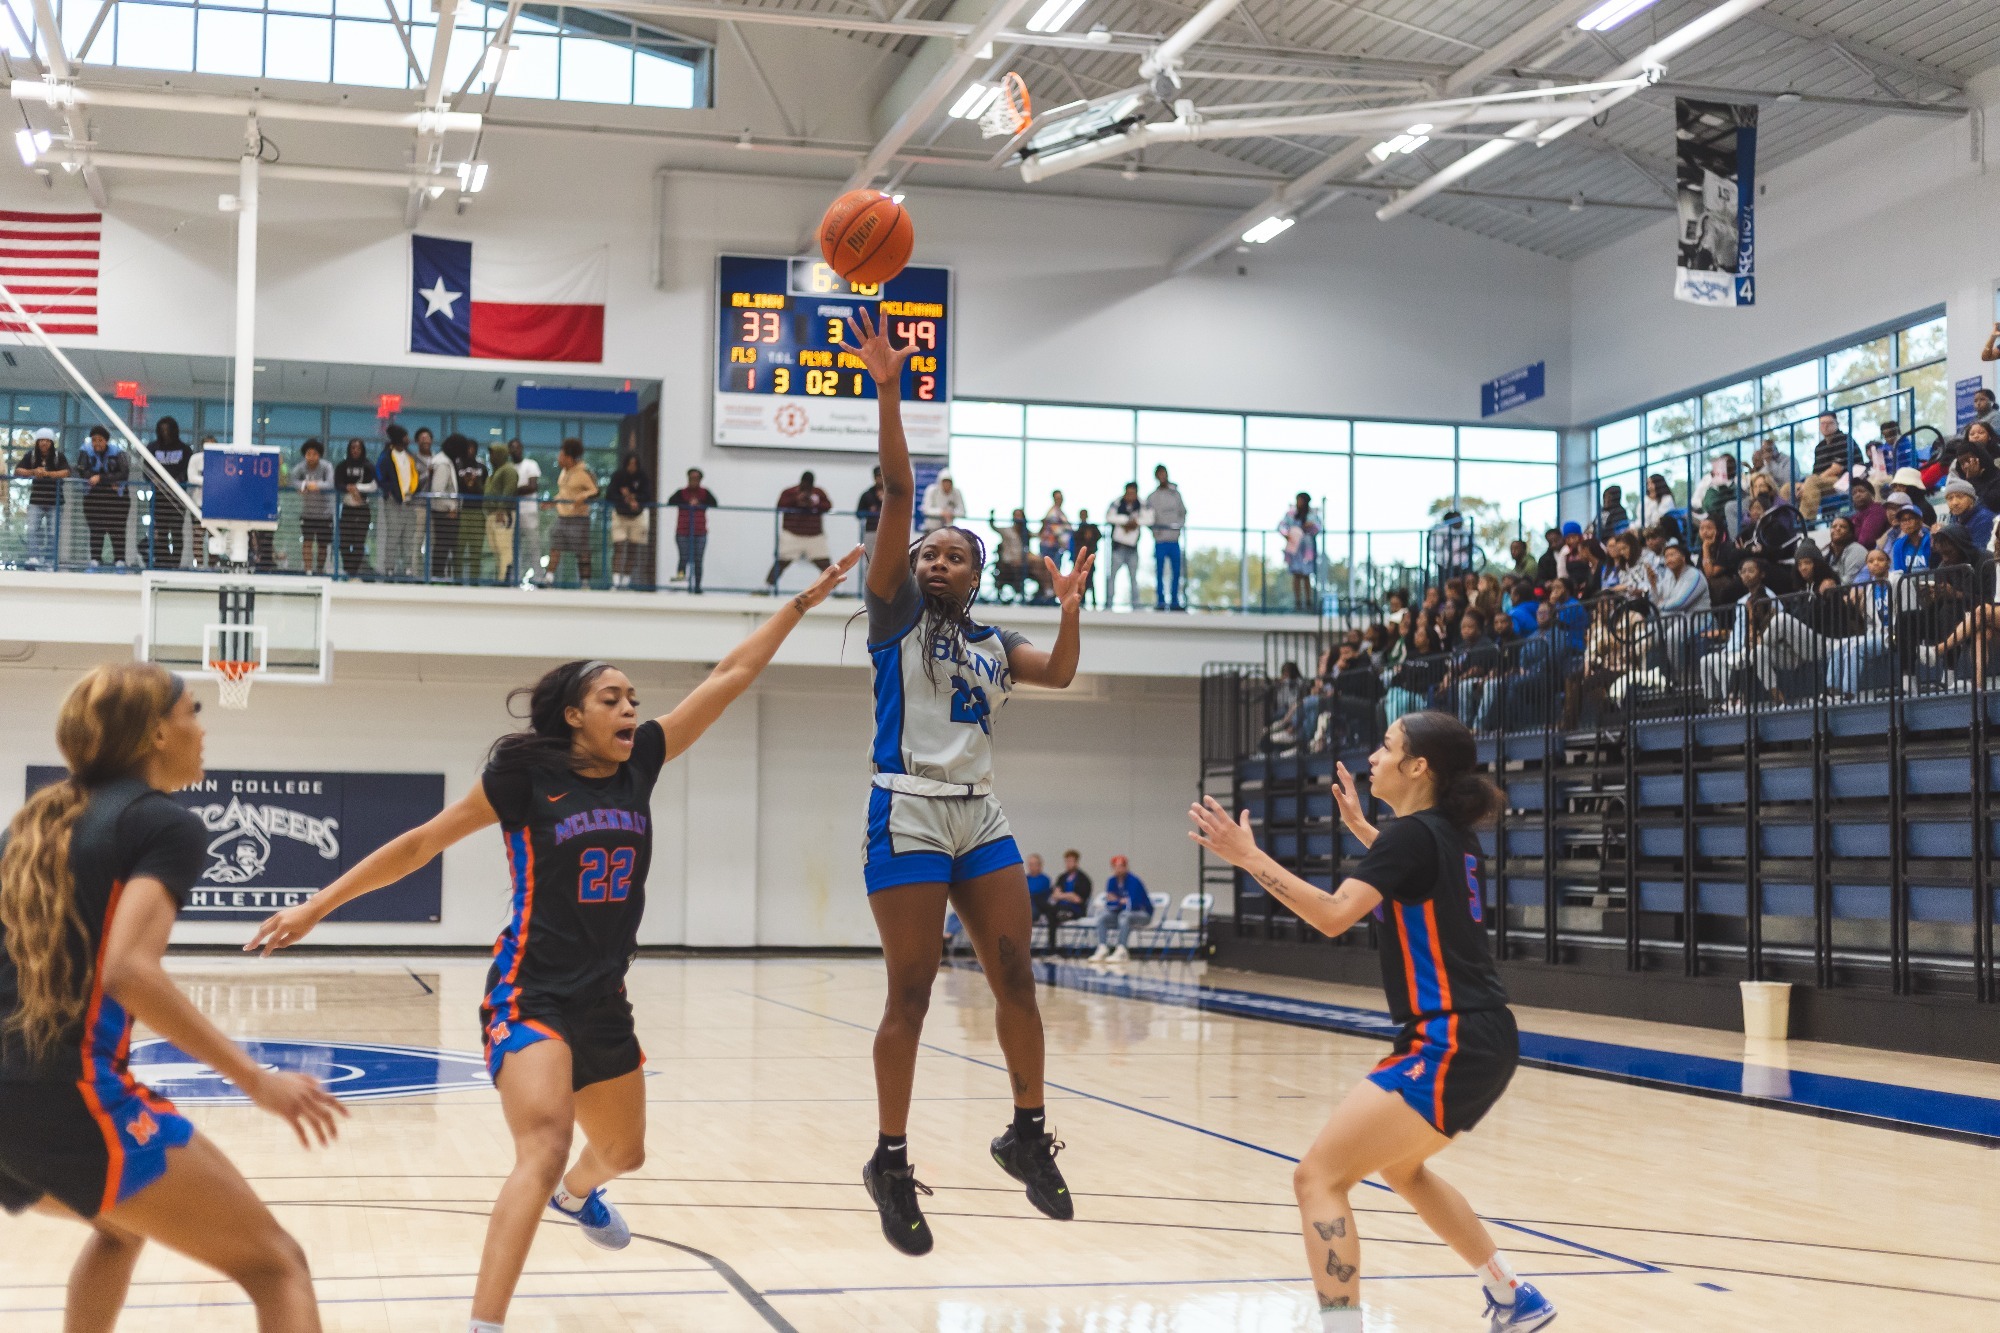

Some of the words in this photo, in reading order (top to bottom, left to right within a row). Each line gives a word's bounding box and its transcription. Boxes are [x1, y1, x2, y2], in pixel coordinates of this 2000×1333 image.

[1739, 278, 1753, 303] 4
[742, 311, 780, 343] 33
[828, 318, 844, 344] 3
[897, 321, 936, 350] 49
[910, 355, 937, 373] FLS
[747, 368, 756, 390] 1
[774, 368, 790, 394] 3
[806, 369, 839, 395] 02
[853, 373, 863, 395] 1
[918, 375, 936, 400] 2
[224, 457, 272, 478] 6:10
[231, 779, 323, 795] COLLEGE
[578, 847, 636, 903] 22
